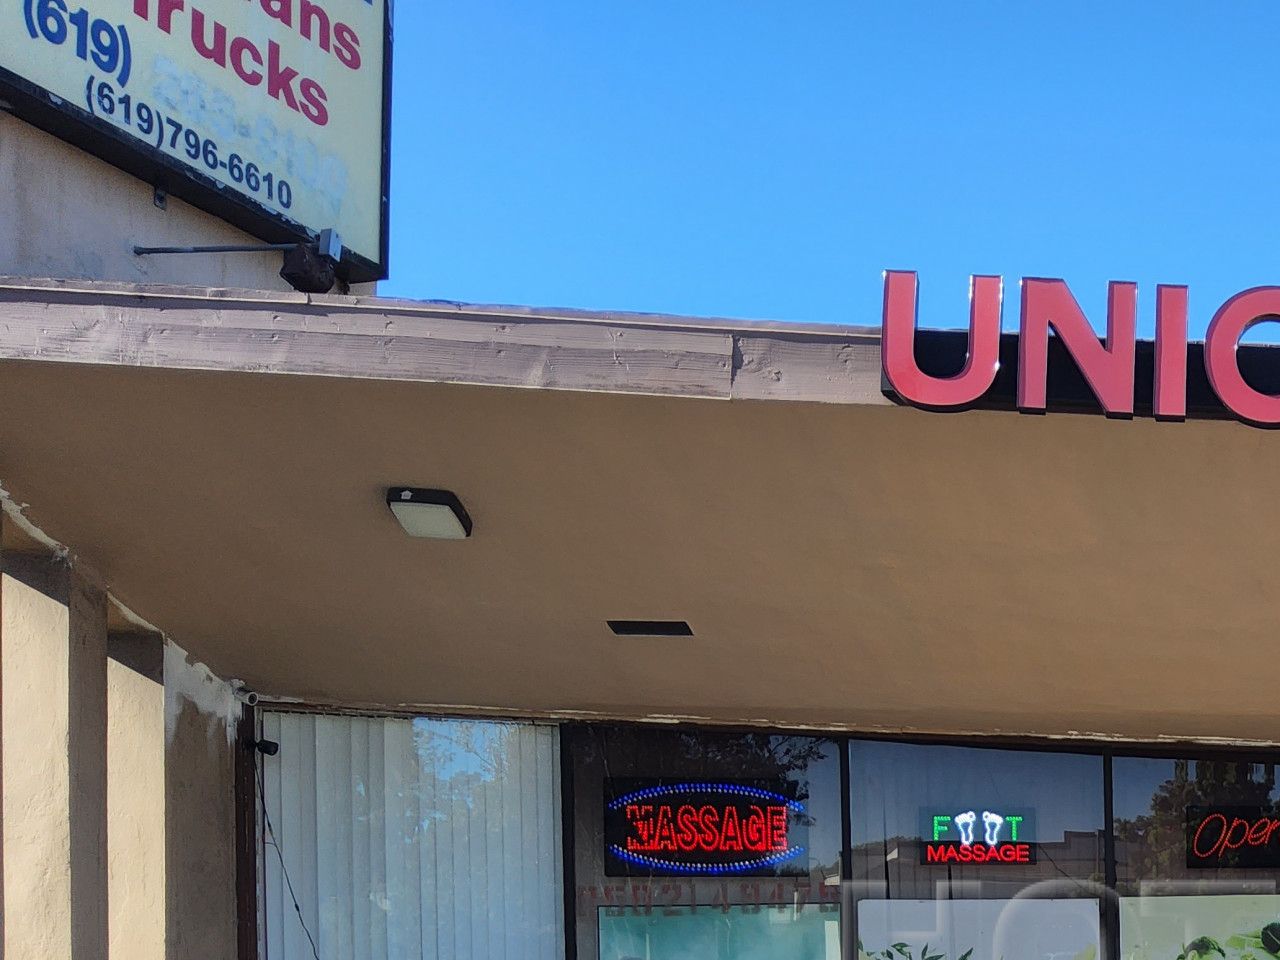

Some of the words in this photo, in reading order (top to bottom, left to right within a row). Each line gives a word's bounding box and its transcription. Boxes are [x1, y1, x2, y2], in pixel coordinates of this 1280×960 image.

[24, 0, 131, 88] (619)
[259, 0, 361, 70] ans
[86, 75, 292, 209] (619)796-6610
[626, 804, 788, 852] MASSAGE
[927, 845, 1030, 863] MASSAGE
